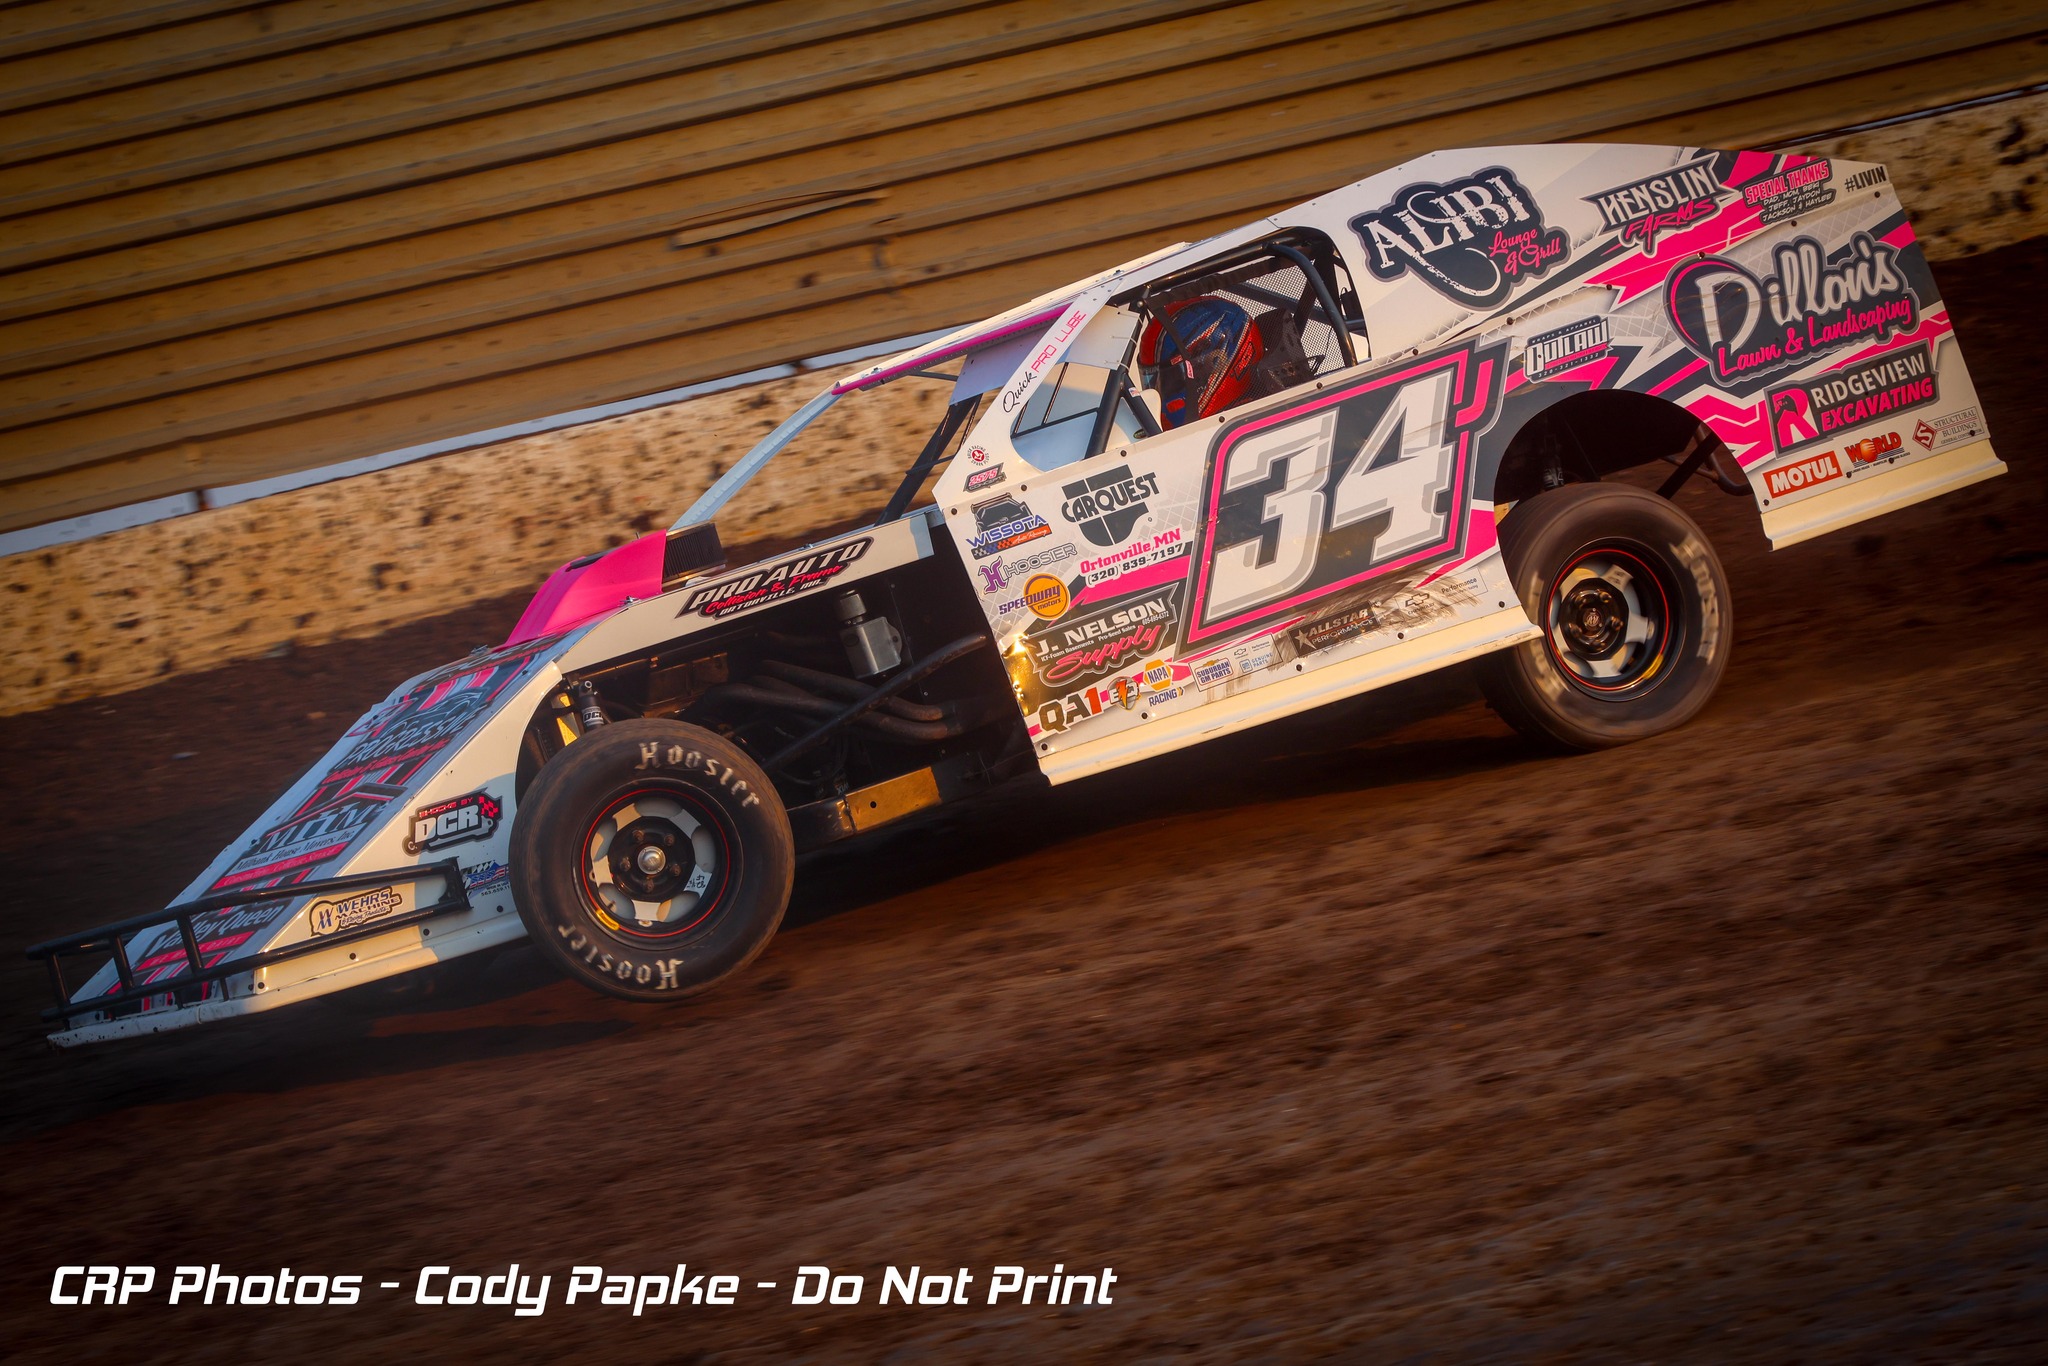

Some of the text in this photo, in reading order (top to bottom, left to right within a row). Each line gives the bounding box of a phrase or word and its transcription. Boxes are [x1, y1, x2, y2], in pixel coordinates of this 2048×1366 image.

[1598, 165, 1716, 226] HENSLIN
[1745, 161, 1829, 204] SPECIAL THANKS
[1845, 166, 1886, 192] #LIVIN
[1489, 228, 1538, 257] Lounge
[1624, 198, 1716, 251] FARMS
[1695, 236, 1899, 356] Dillon's
[1526, 320, 1608, 376] OUTLAW
[1717, 298, 1911, 375] Lawn & Landscaping
[1003, 310, 1087, 413] Quick PRO LUBE
[1811, 362, 1926, 408] RIDGEVIEW
[1821, 378, 1934, 432] EXCAVATING
[1934, 410, 1977, 428] STRUCTURAL
[1942, 422, 1978, 437] BUILDINGS
[1771, 457, 1839, 495] MOTUL
[1061, 472, 1160, 523] CARQUEST
[1205, 370, 1453, 621] 34
[966, 514, 1047, 548] WISSOTA
[689, 541, 867, 610] PRO AUTO
[1004, 543, 1077, 579] HOOSIER
[1087, 543, 1183, 585] (320) 839-7197
[705, 588, 768, 614] Collision
[998, 584, 1061, 615] SPEEDWAY
[1037, 598, 1062, 611] motors
[1036, 597, 1167, 657] J. NELSON
[1307, 608, 1369, 637] ALLSTAR
[1047, 624, 1161, 680] Supply
[1196, 660, 1230, 678] SUBURBAN
[1147, 666, 1169, 684] NAPA
[1200, 675, 1212, 684] GM
[1211, 667, 1231, 681] PARTS
[1040, 686, 1103, 732] QA1
[1148, 689, 1178, 707] RACING
[635, 741, 760, 808] Hoosier
[414, 804, 480, 843] DCR
[218, 905, 285, 936] Queen
[335, 896, 401, 920] MACHINE
[337, 890, 391, 916] WEHRS
